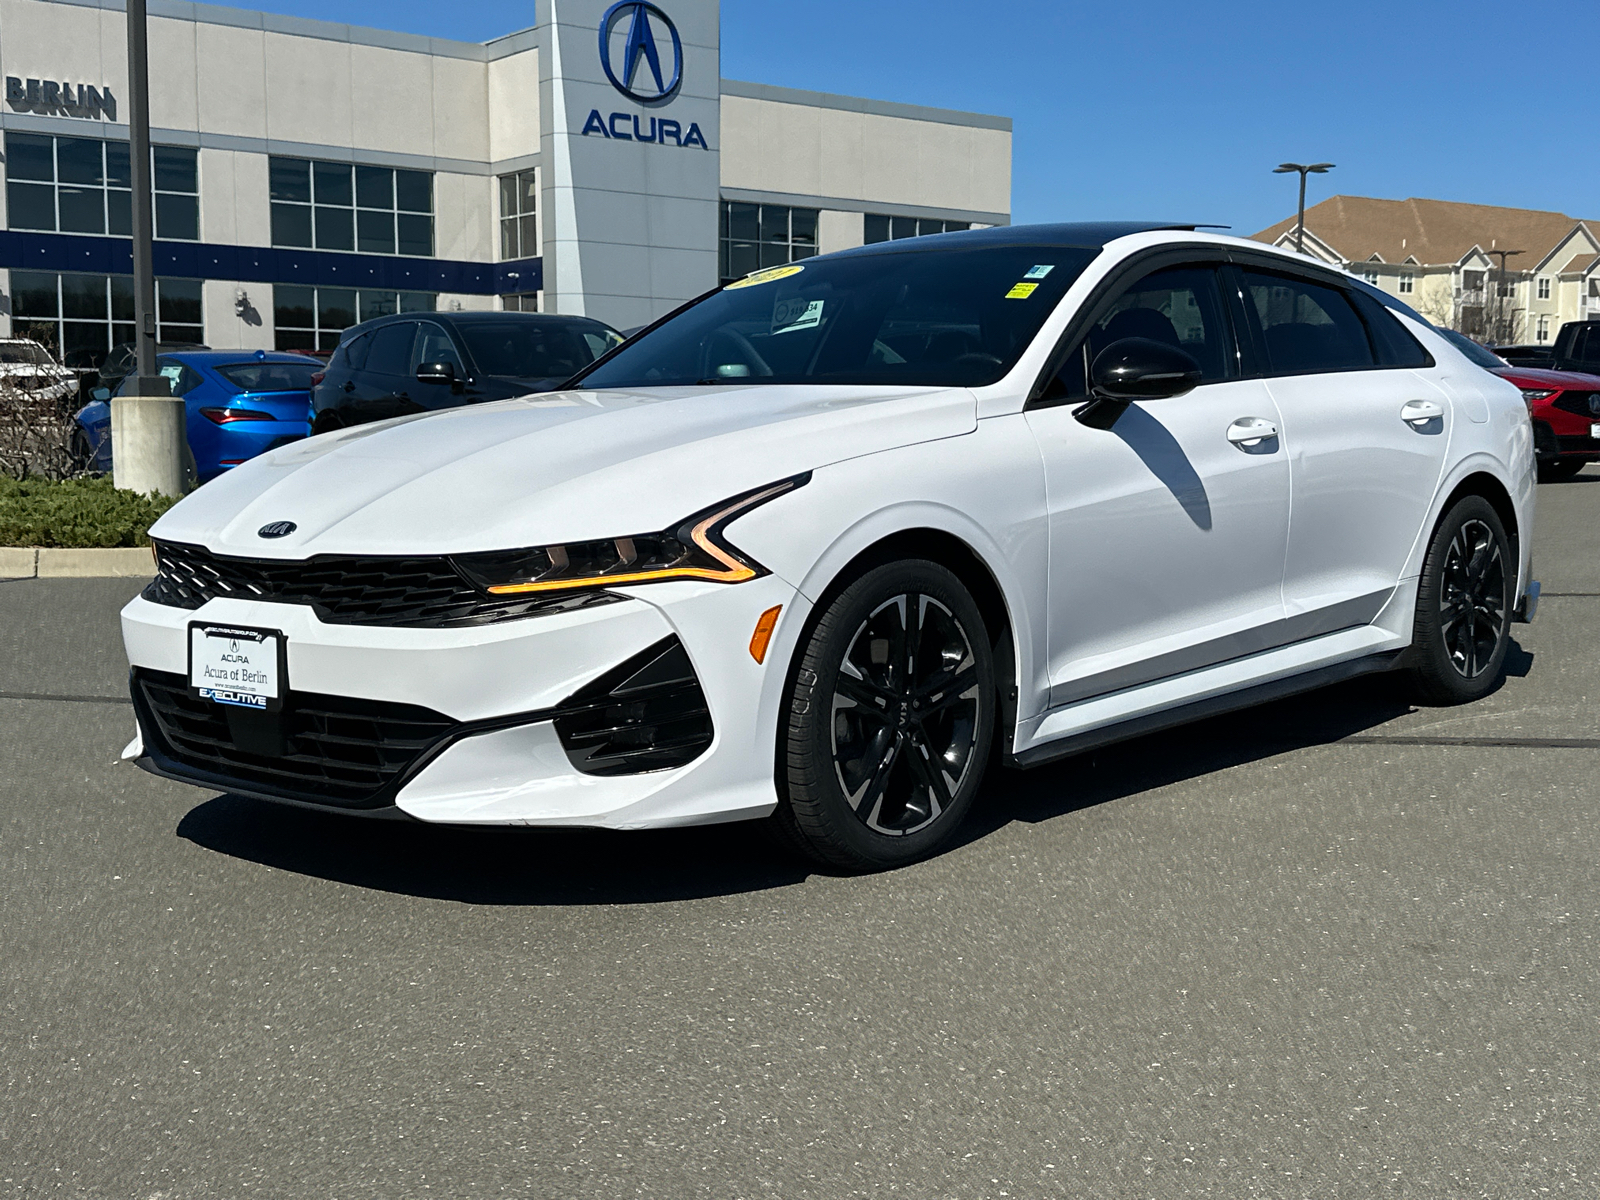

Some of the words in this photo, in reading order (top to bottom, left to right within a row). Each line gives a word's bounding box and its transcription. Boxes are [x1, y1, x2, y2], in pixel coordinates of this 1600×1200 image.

[6, 76, 111, 110] BERLIN
[582, 109, 708, 151] ACURA
[260, 522, 290, 535] KIA
[221, 654, 249, 664] ACURA
[204, 665, 228, 680] Acura
[230, 669, 239, 681] of
[241, 669, 268, 684] Berlin
[199, 688, 266, 705] EXECUTIVE
[898, 702, 908, 726] KIA
